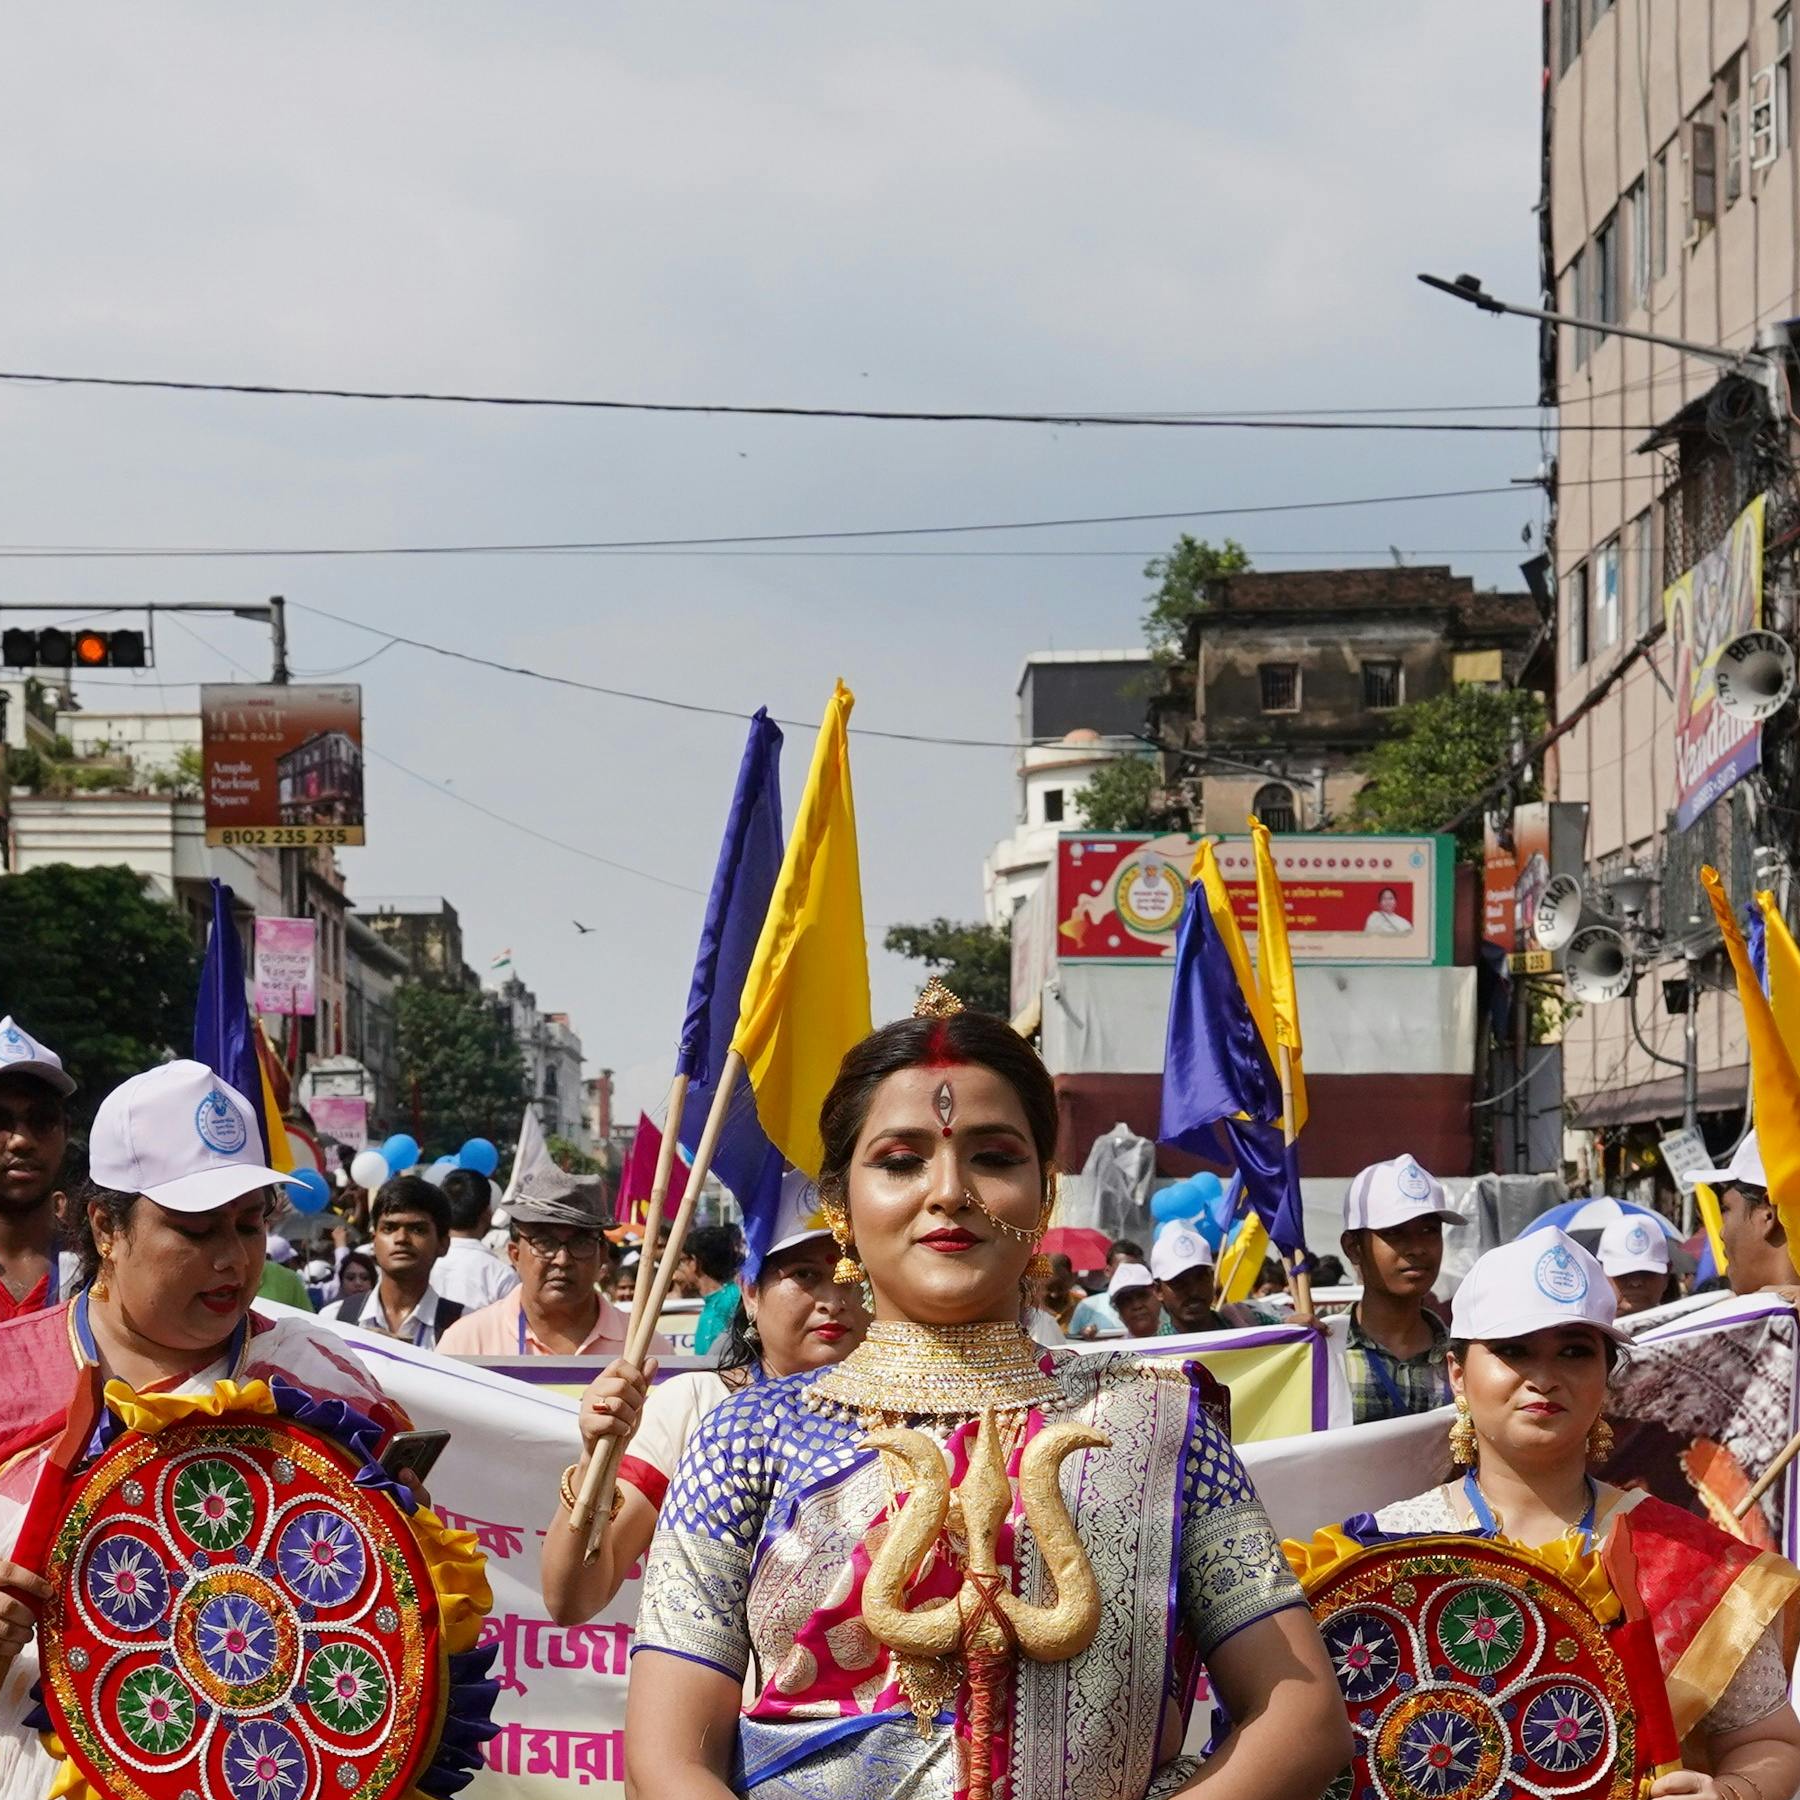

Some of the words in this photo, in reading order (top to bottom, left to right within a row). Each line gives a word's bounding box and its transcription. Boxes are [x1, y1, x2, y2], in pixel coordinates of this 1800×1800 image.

[250, 733, 285, 741] ROAD
[212, 761, 253, 778] Ample
[211, 776, 260, 793] Parking
[211, 794, 250, 810] Space
[222, 829, 266, 845] 8102
[273, 829, 306, 845] 235
[315, 829, 347, 844] 235
[1537, 877, 1576, 934] BETAR
